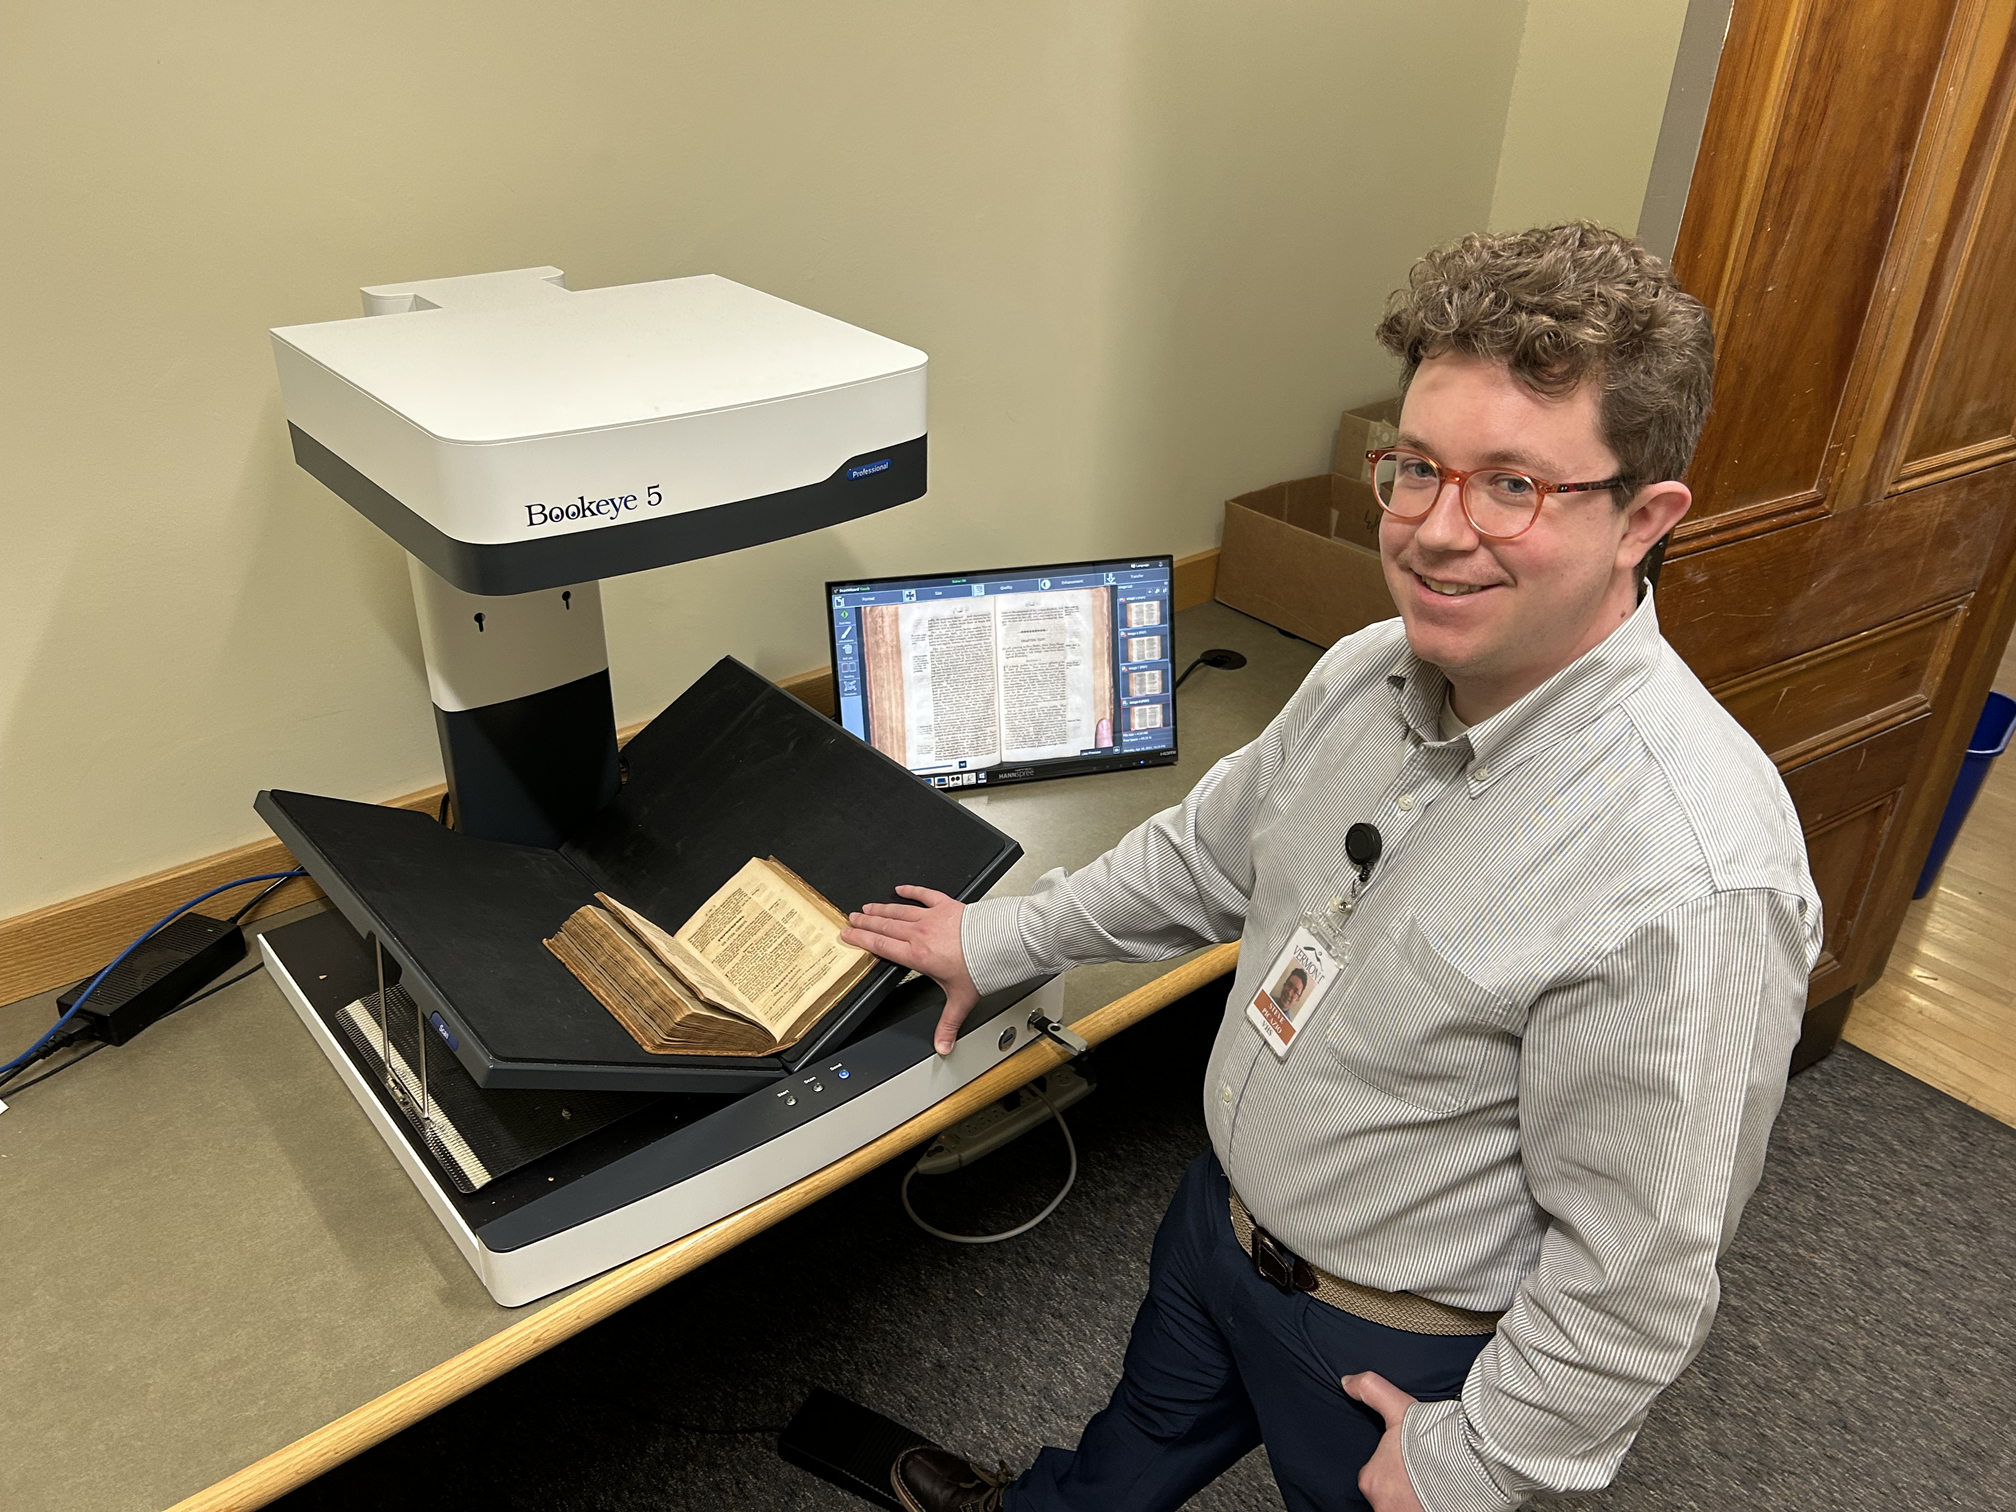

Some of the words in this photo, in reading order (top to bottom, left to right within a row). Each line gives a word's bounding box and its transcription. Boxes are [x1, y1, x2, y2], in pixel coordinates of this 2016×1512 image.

[852, 462, 890, 479] Professional
[525, 494, 638, 527] Bookeye
[646, 484, 664, 507] 5
[1293, 945, 1325, 985] VERMONT
[1261, 1007, 1283, 1034] PICAZIO
[1268, 1002, 1285, 1025] STEVE
